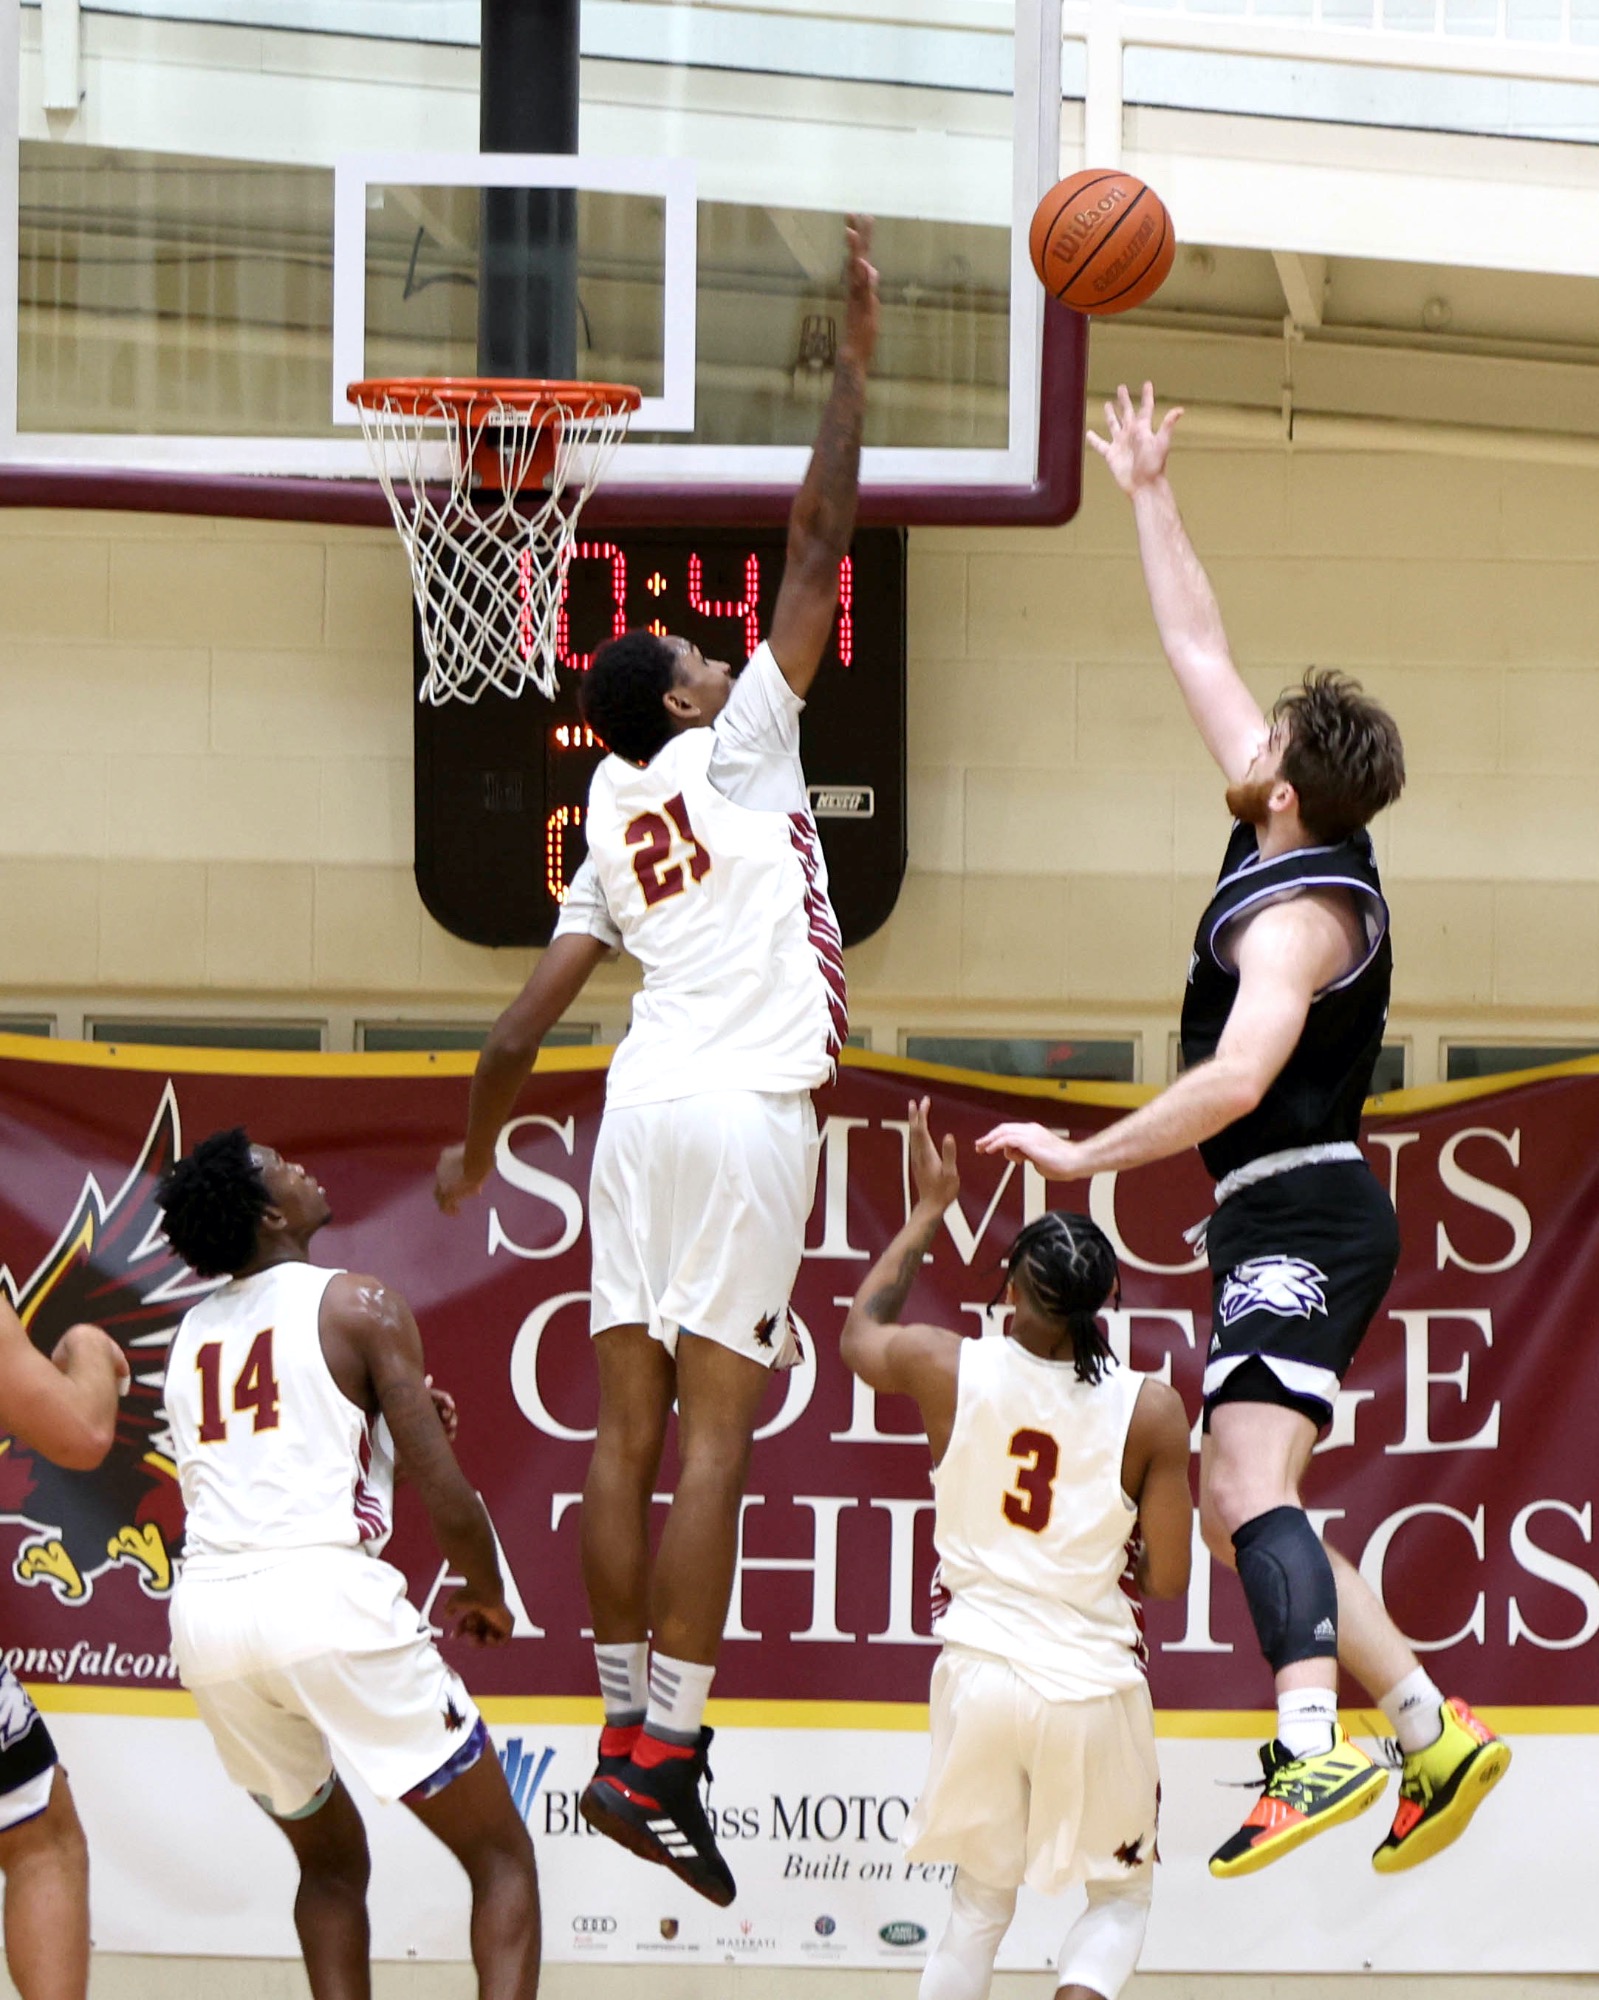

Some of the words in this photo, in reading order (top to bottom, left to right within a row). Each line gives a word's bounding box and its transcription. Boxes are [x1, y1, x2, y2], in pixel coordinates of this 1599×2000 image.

[1052, 187, 1127, 263] Wilson
[625, 792, 712, 911] 21
[195, 1327, 281, 1445] 14
[1001, 1428, 1059, 1535] 3
[0, 1640, 179, 1682] onsfalcon
[770, 1794, 919, 1843] MOTO
[783, 1853, 850, 1880] Built
[859, 1862, 892, 1880] on
